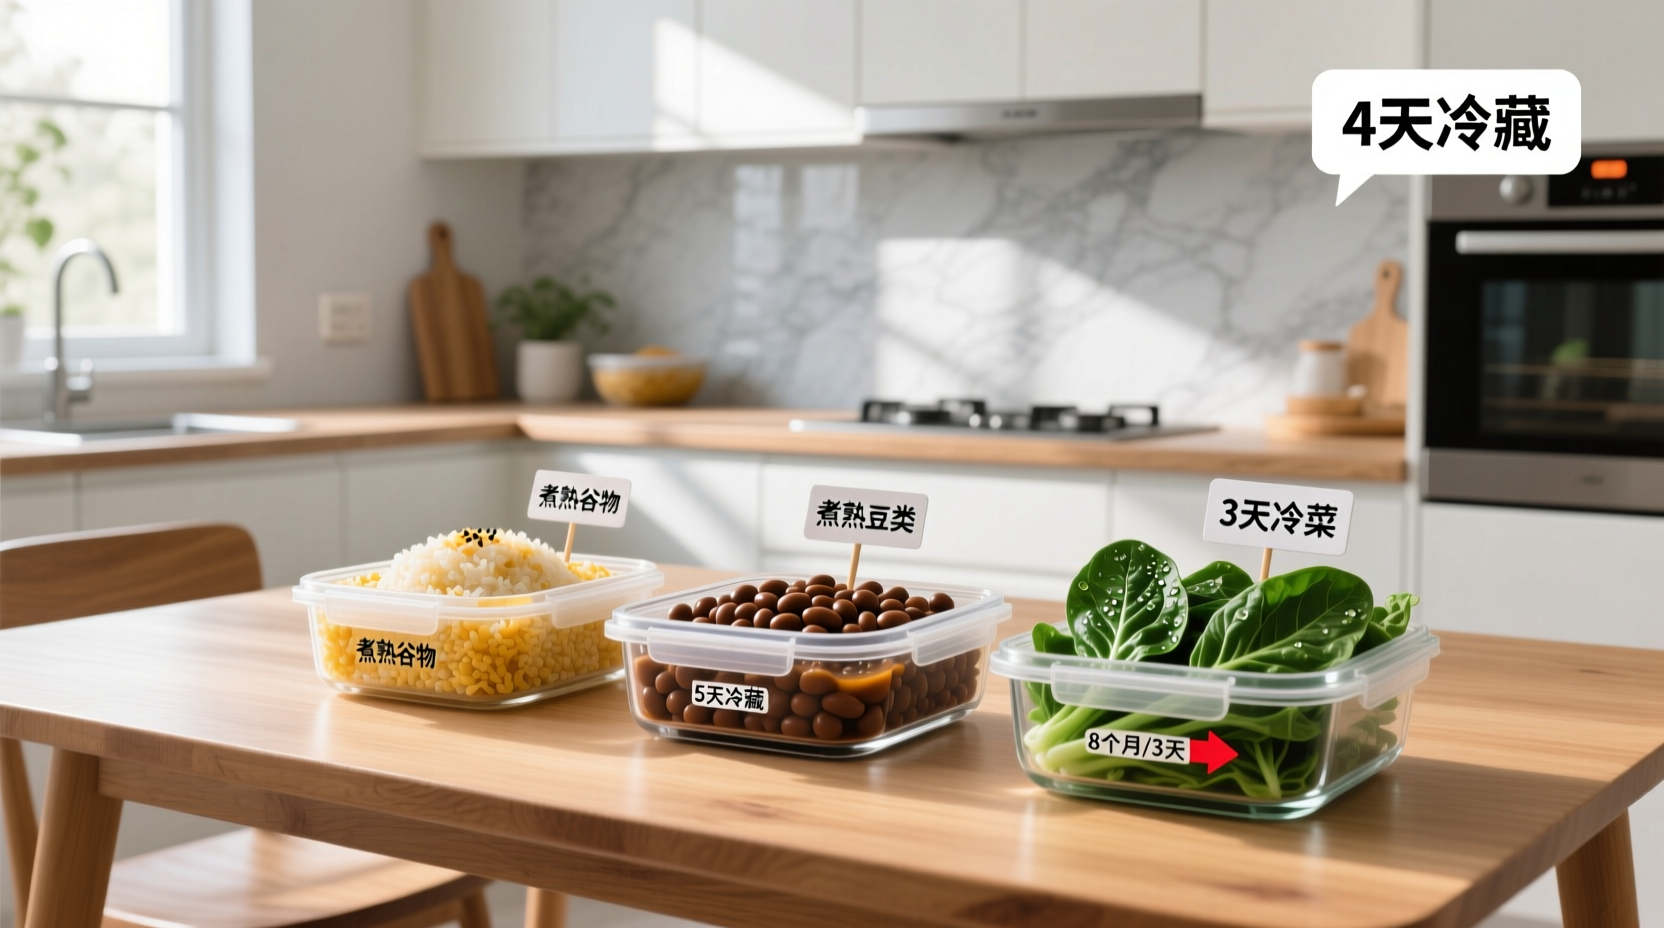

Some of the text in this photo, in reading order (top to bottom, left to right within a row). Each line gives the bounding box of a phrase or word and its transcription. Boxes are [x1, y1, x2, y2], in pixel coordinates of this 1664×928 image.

[539, 484, 621, 514] 煮熟谷物
[816, 499, 916, 534] 煮熟豆类
[1219, 498, 1338, 539] 3天冷菜
[356, 637, 437, 670] 煮熟谷物
[1088, 732, 1185, 761] 8个月/3天
